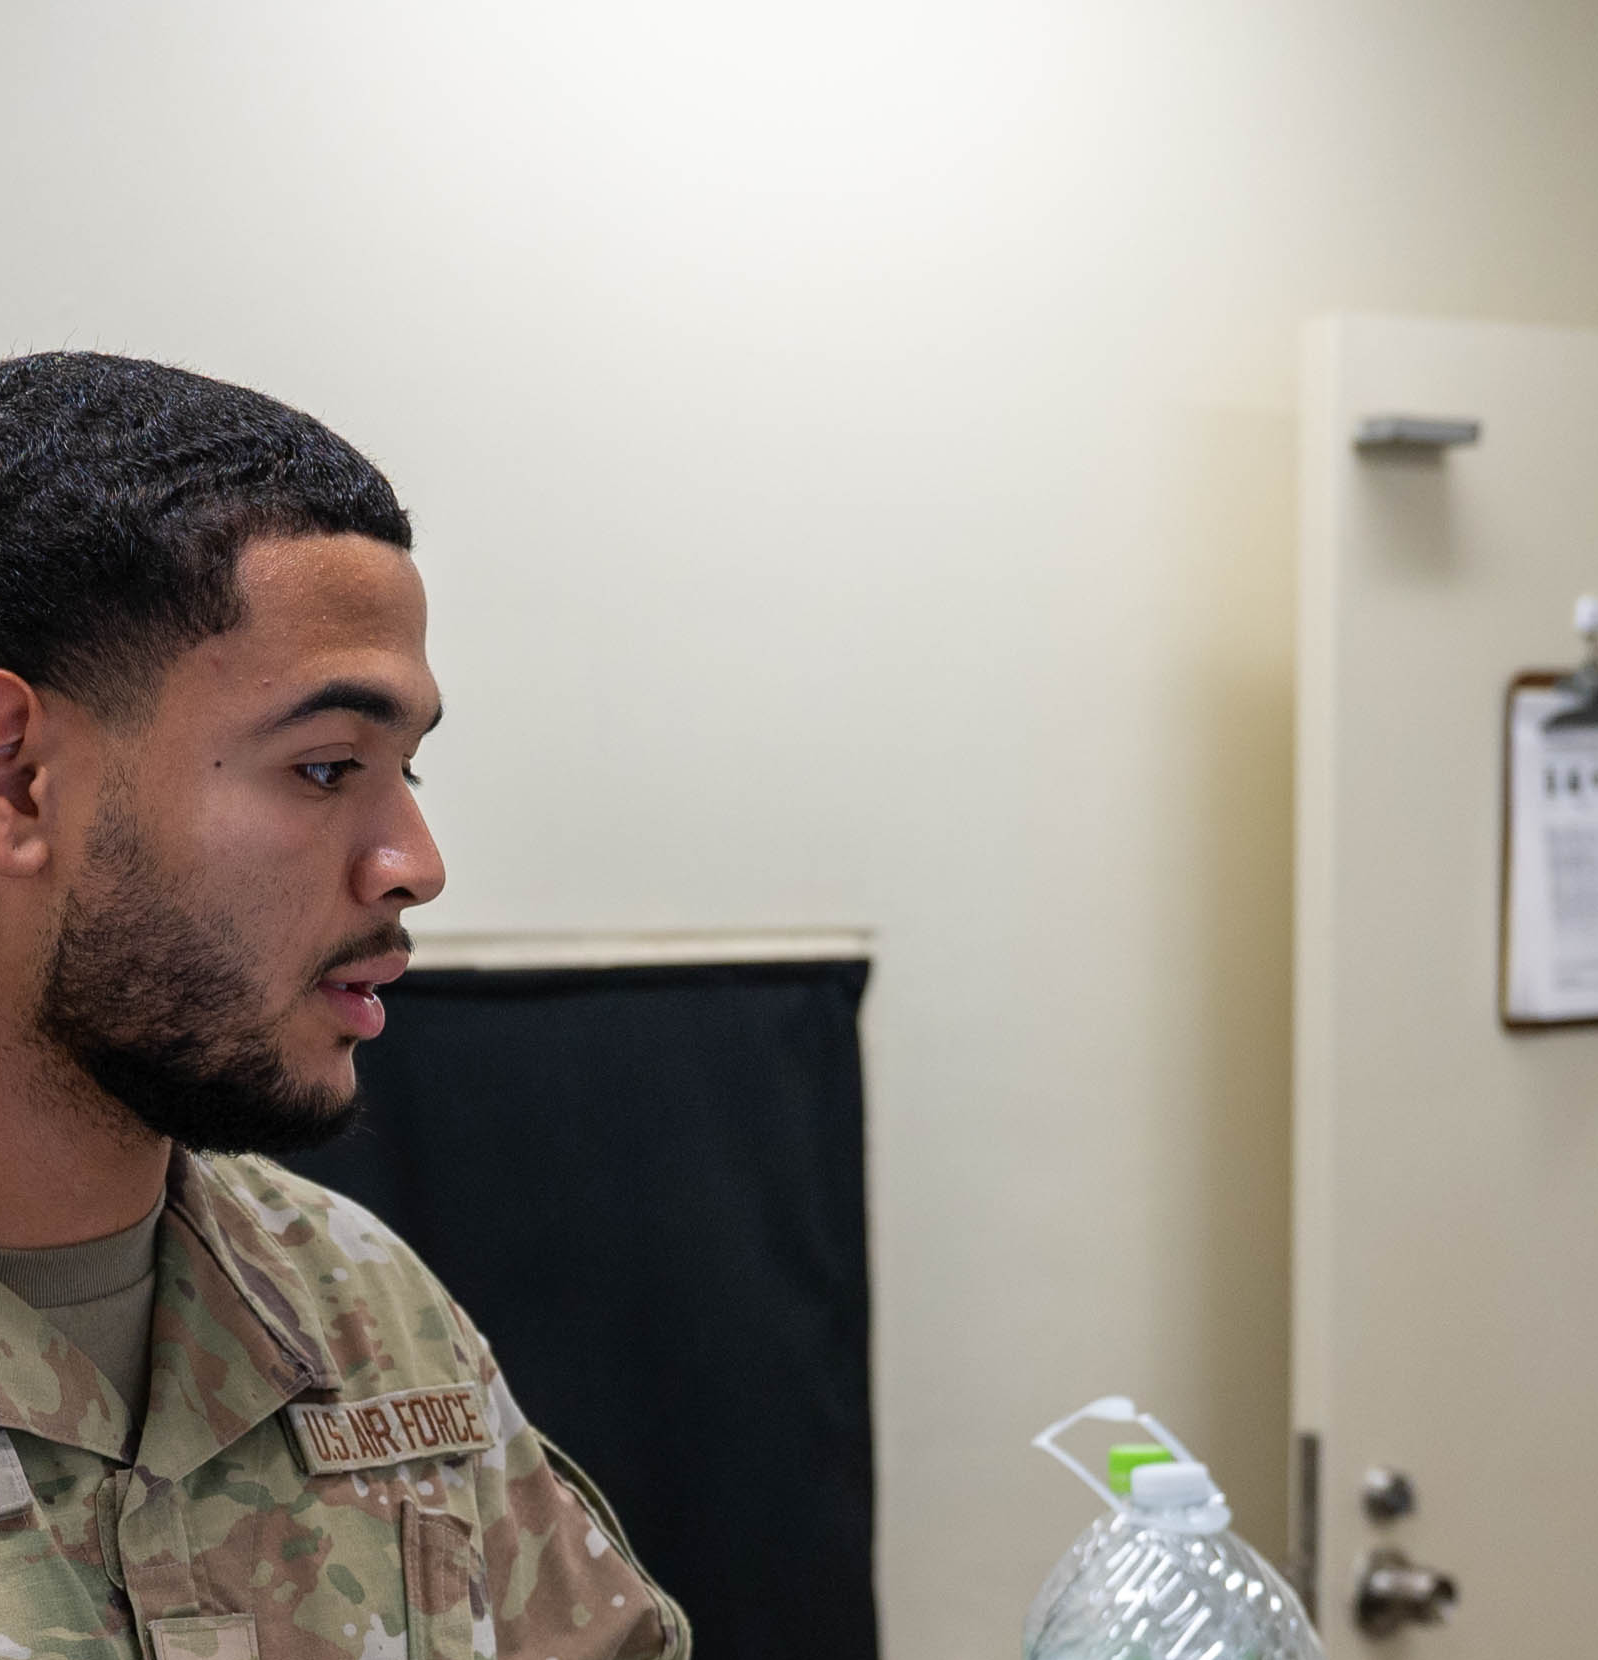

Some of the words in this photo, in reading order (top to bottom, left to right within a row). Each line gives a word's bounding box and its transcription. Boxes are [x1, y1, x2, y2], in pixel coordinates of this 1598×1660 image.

[302, 1410, 358, 1461] U.S.
[345, 1407, 402, 1458] AIR
[390, 1392, 484, 1450] FORCE
